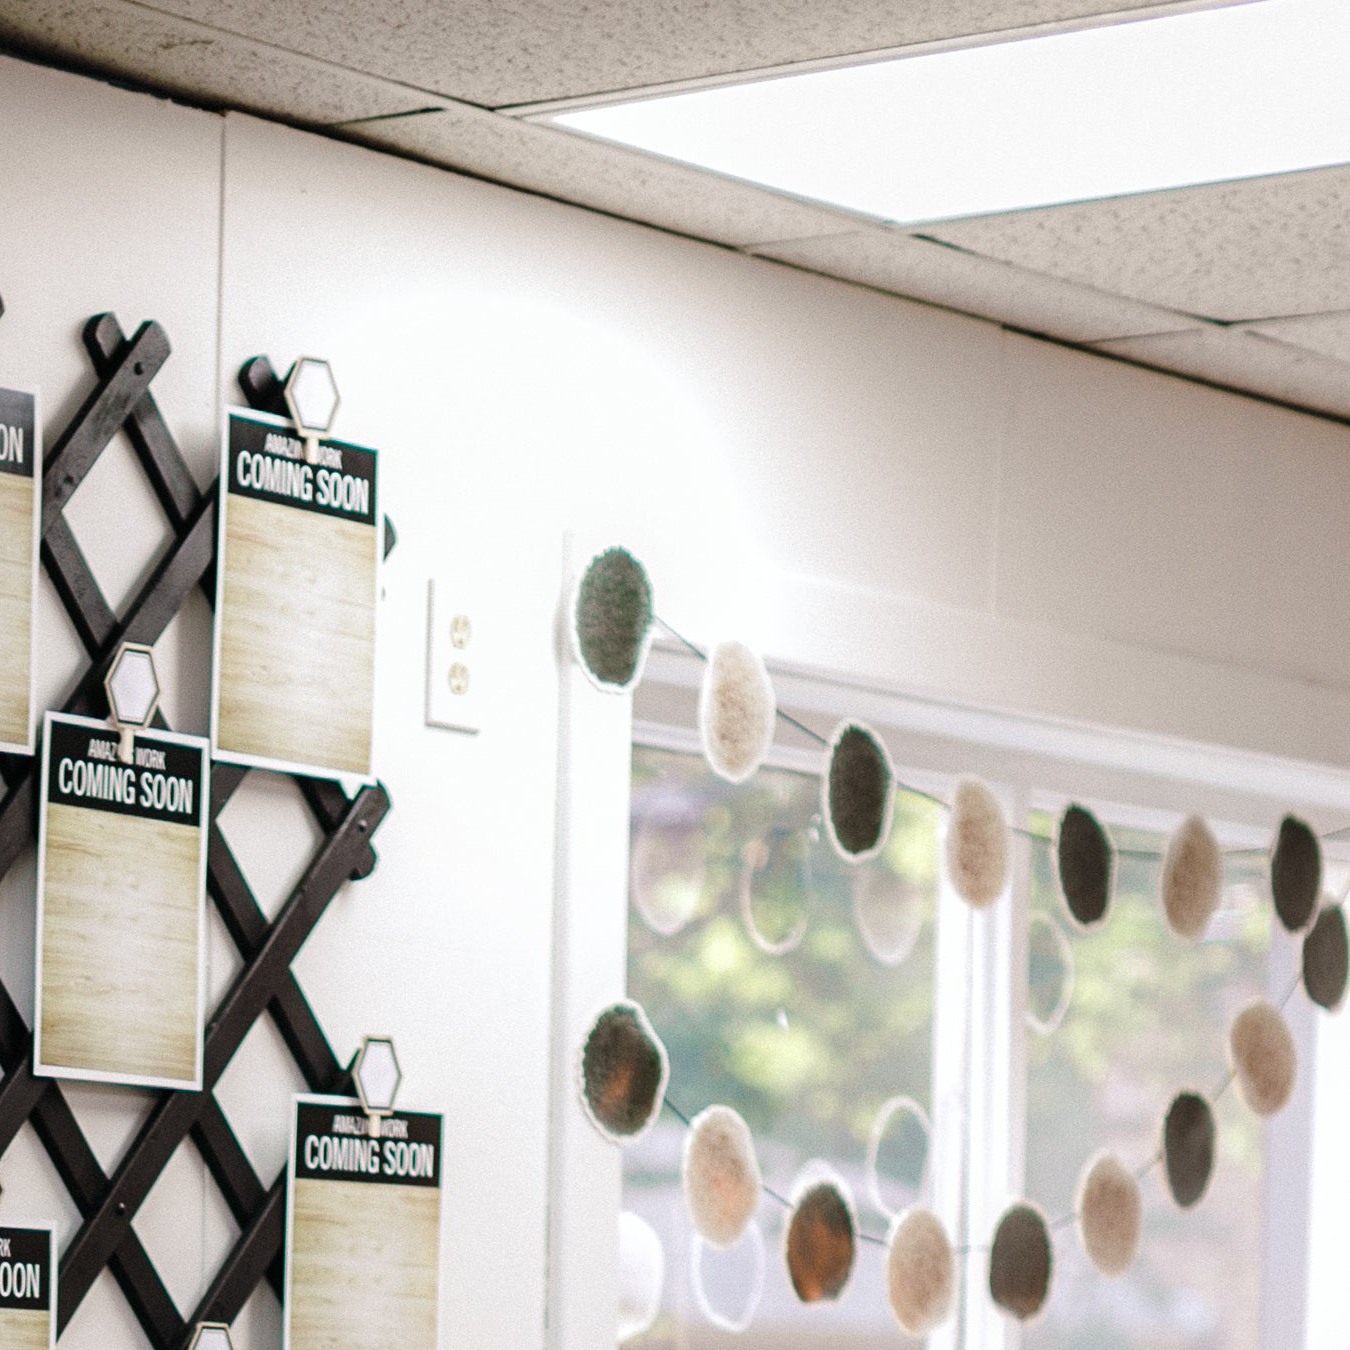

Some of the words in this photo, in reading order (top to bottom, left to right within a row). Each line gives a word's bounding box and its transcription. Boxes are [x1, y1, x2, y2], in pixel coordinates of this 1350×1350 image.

[236, 450, 313, 502] COMING
[316, 469, 369, 514] SOON
[136, 748, 166, 770] WORK
[58, 758, 135, 805] COMING
[140, 772, 193, 814] SOON
[304, 1135, 380, 1173] COMING
[383, 1140, 434, 1178] SOON
